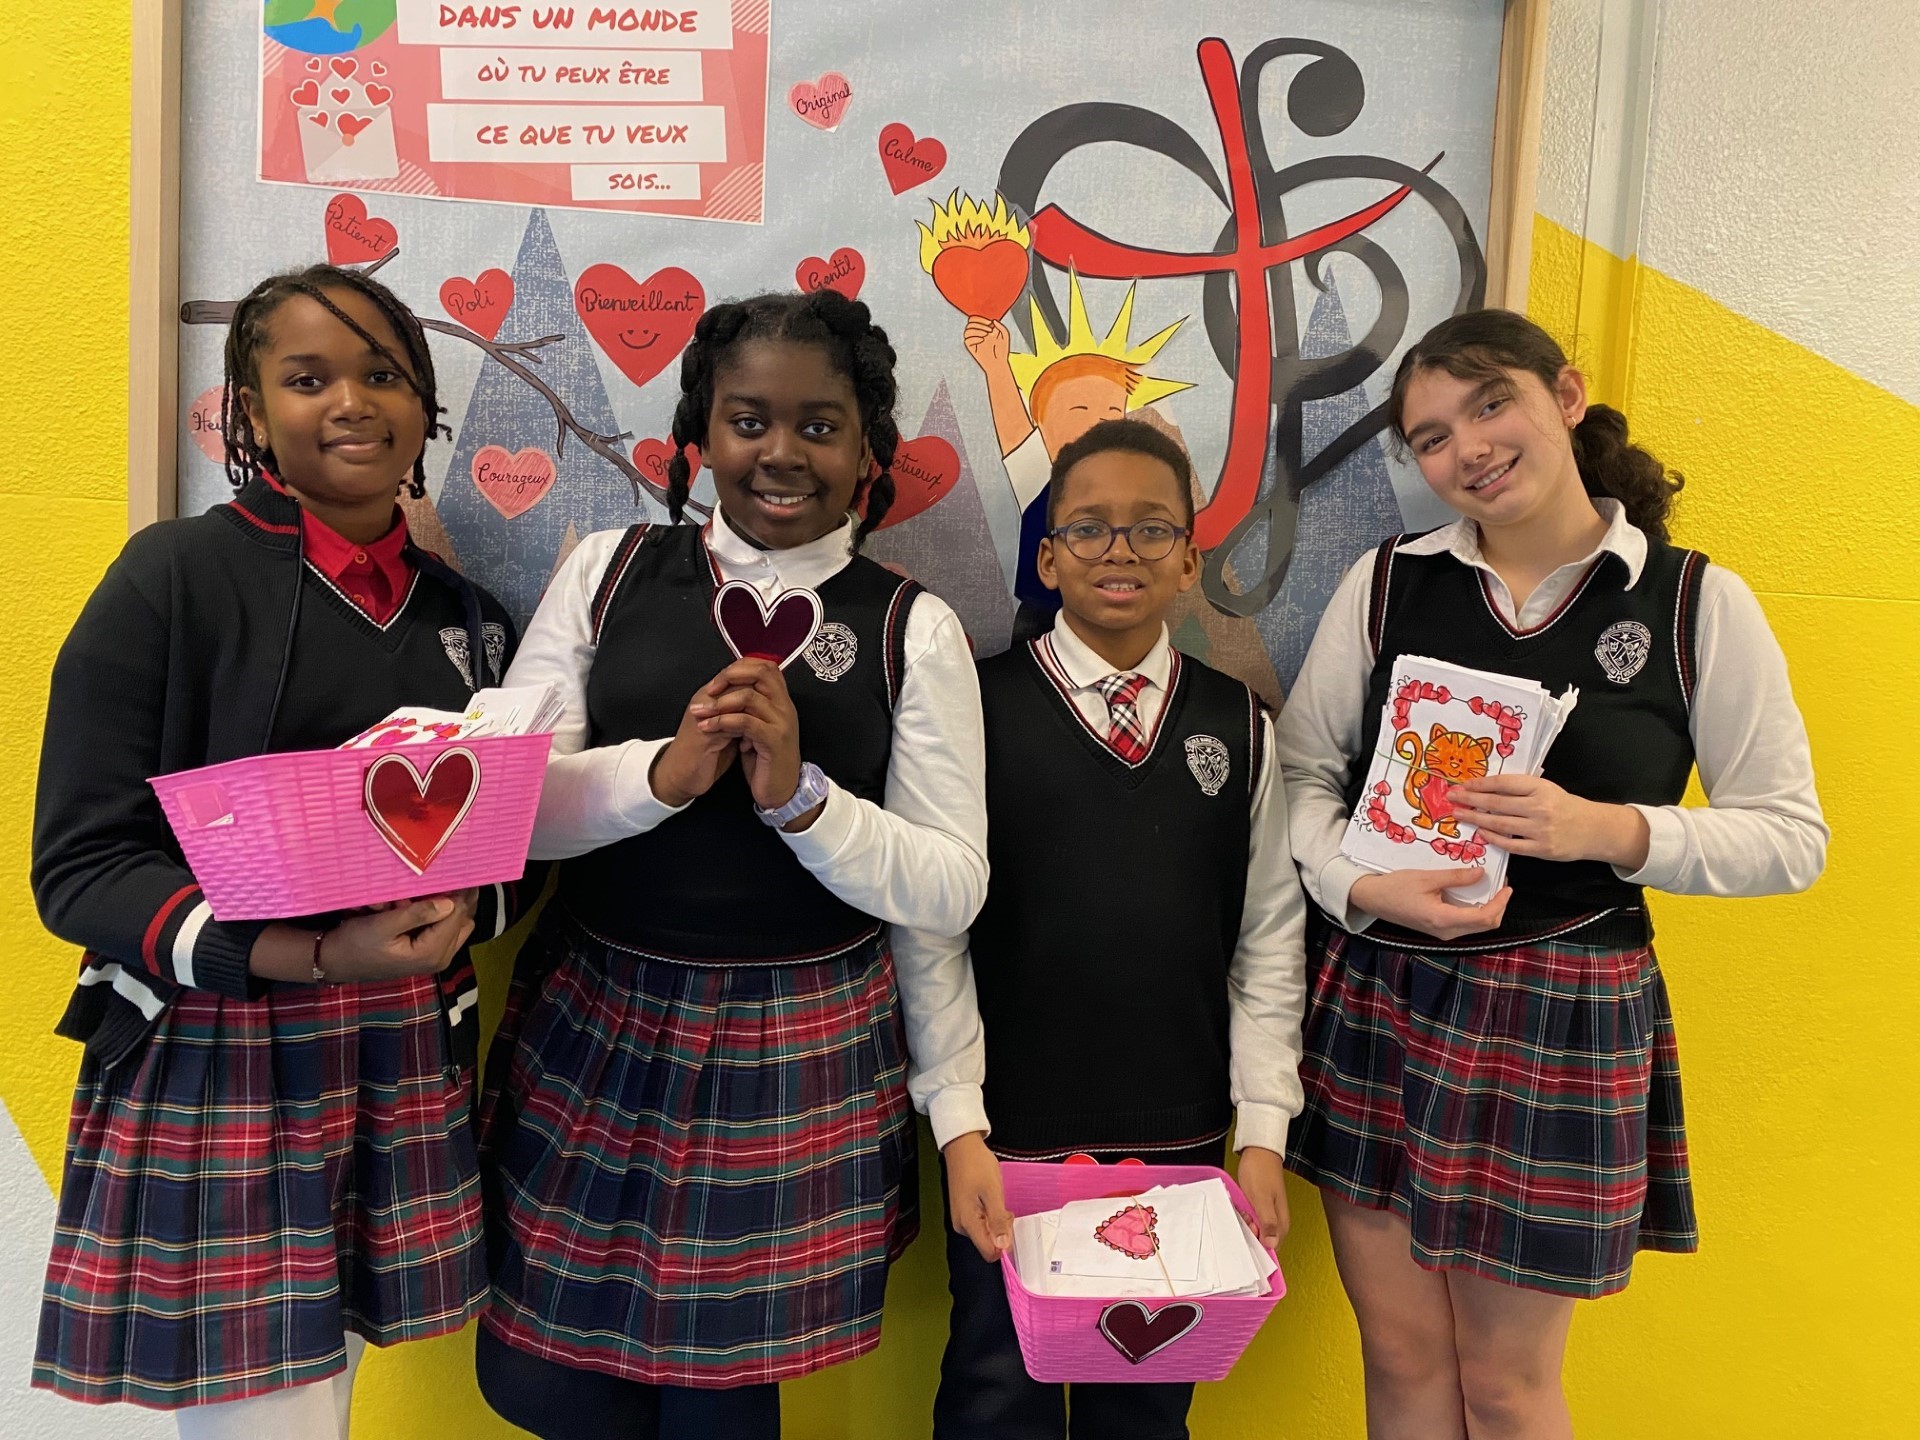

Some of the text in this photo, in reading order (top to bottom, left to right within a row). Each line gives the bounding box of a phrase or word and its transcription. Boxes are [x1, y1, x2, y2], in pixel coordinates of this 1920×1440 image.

[439, 4, 698, 33] DANS UN MONDE
[477, 56, 671, 85] OÙ TU PEUX ÊTRE
[796, 82, 852, 119] Original
[476, 125, 689, 146] CE QUE TU VEUX
[884, 138, 934, 172] Calme
[608, 173, 672, 191] SOIS...
[326, 202, 387, 252] Patient
[807, 255, 856, 290] Gentil
[447, 288, 496, 316] Poli
[579, 287, 700, 314] Bienveillant
[477, 463, 551, 494] Courageux
[891, 453, 943, 490] ctueux
